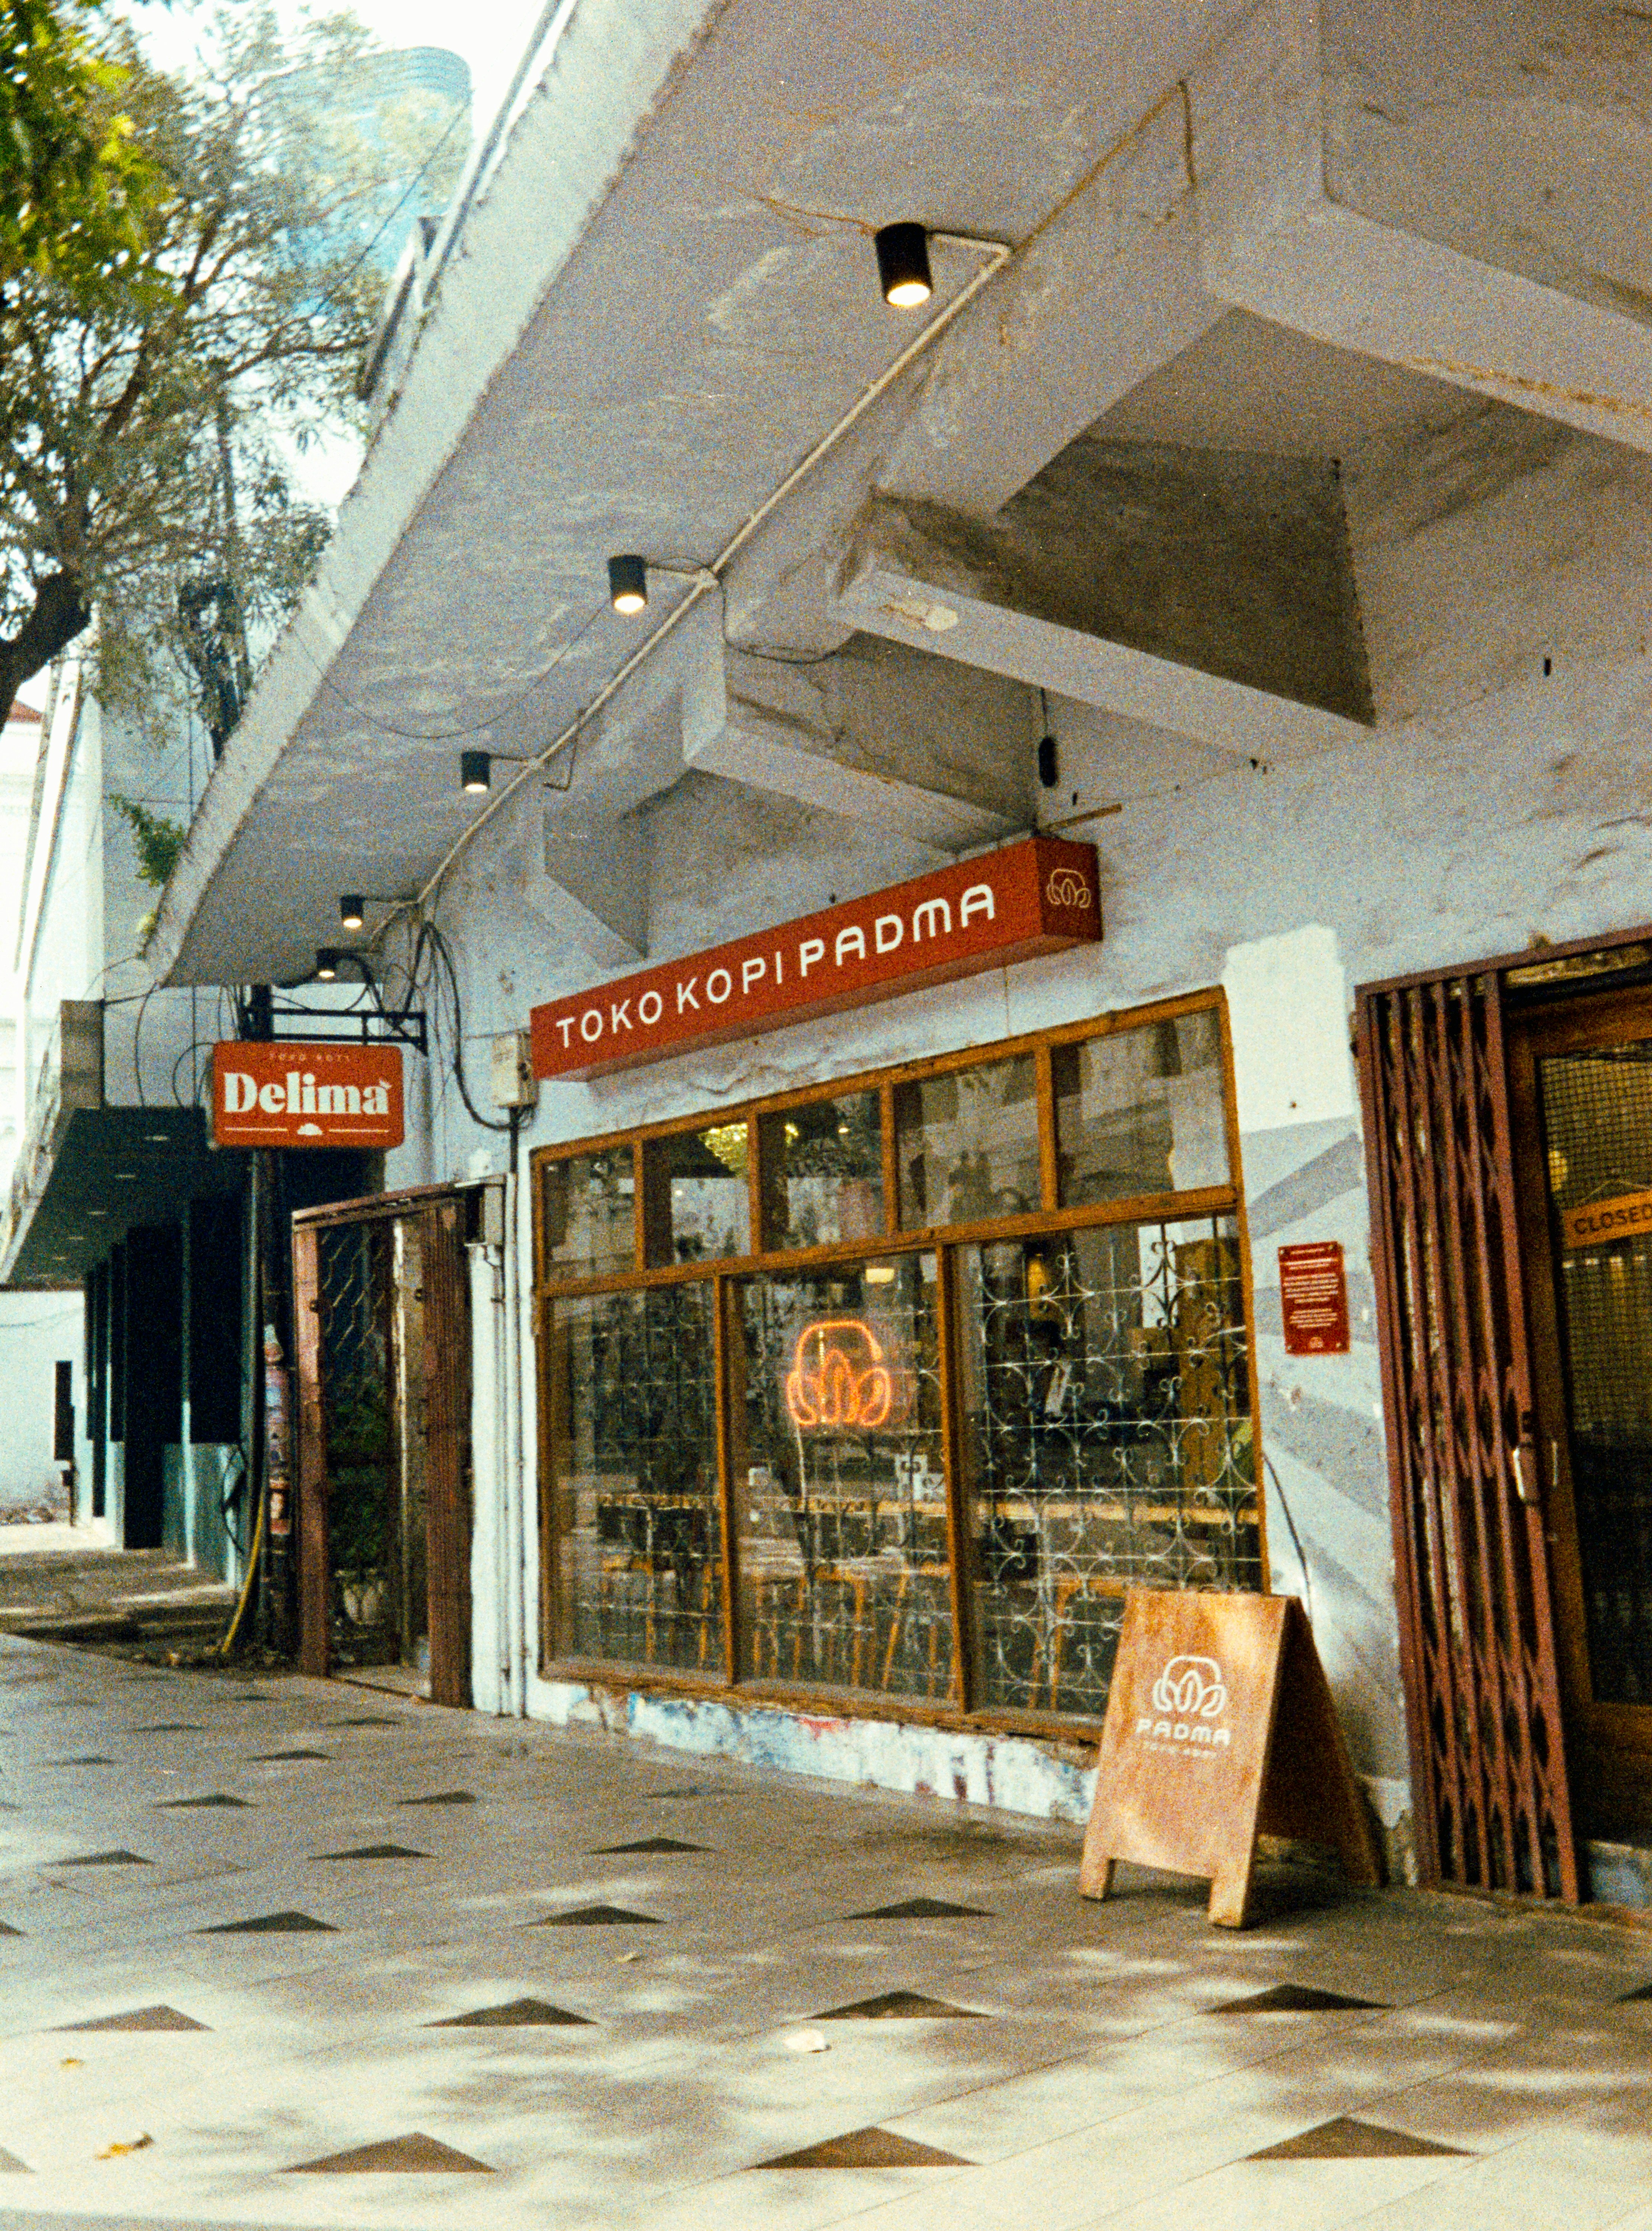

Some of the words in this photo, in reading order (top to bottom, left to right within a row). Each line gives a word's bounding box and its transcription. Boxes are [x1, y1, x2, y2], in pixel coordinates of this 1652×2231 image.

[556, 991, 662, 1048] TOKO
[677, 950, 783, 1014] KOPI
[800, 884, 995, 977] PADMA
[1573, 1203, 1652, 1234] CLOSED
[1136, 1718, 1231, 1747] PADMA
